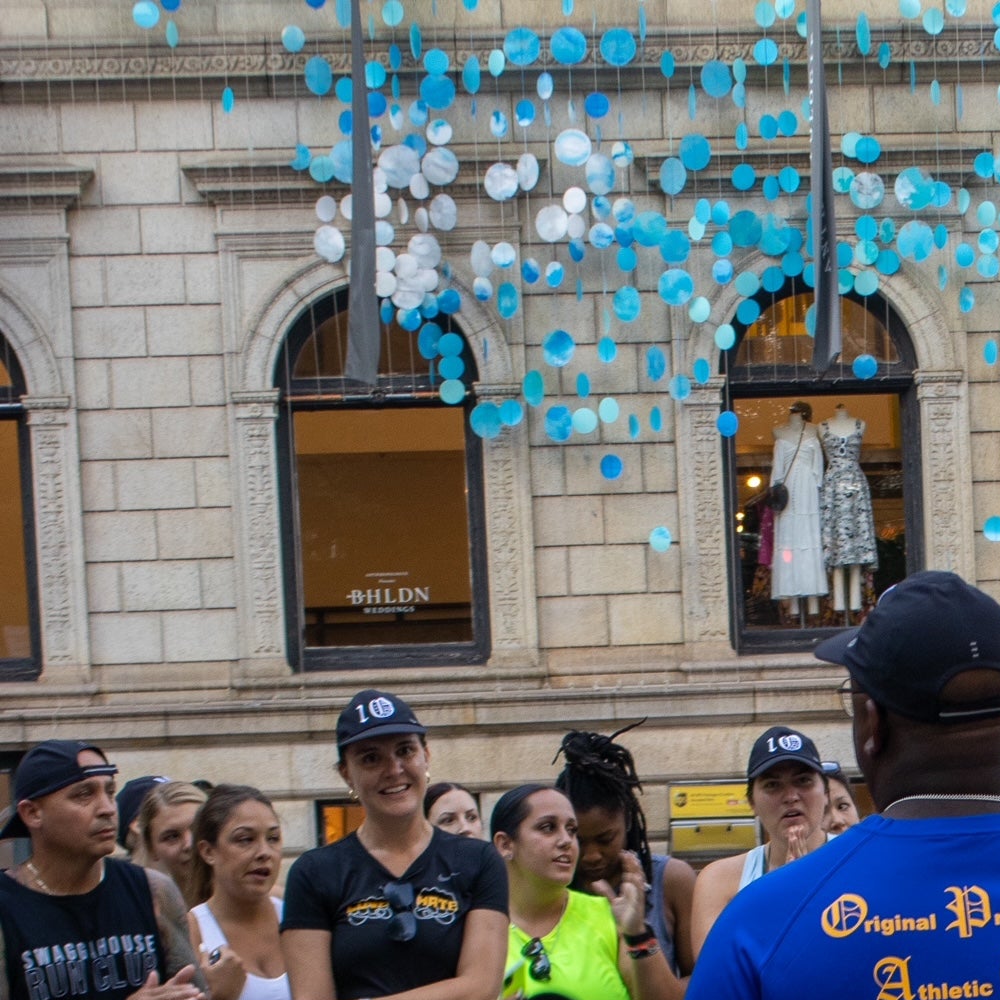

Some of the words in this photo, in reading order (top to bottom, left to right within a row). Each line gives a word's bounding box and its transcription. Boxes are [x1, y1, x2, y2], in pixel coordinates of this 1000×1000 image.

[346, 586, 431, 605] BHLDN
[363, 605, 416, 615] WEDDINGS
[821, 893, 937, 938] Original
